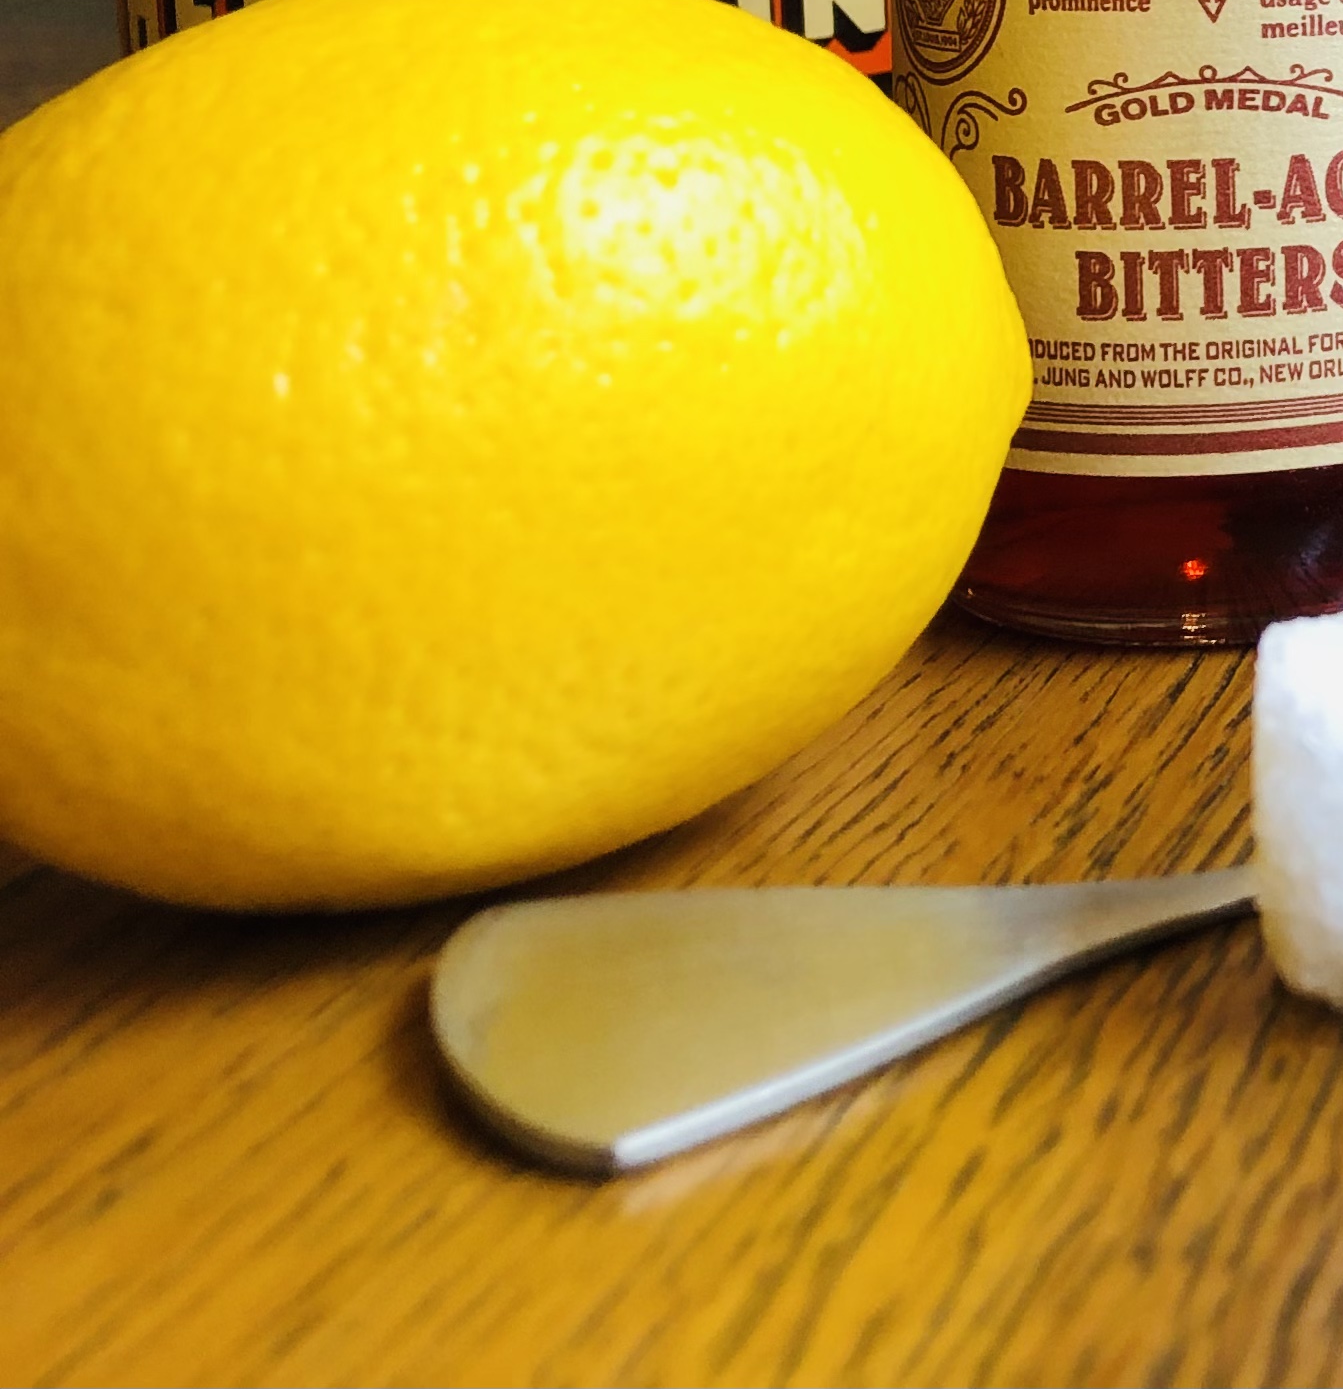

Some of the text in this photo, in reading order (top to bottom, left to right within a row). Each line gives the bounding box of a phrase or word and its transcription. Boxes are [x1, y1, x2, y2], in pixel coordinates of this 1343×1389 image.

[1093, 88, 1330, 127] GOLD MEDAL
[1030, 338, 1096, 363] DUCED
[1100, 340, 1156, 364] FROM
[1163, 341, 1201, 363] THE
[1205, 334, 1304, 361] ORIGINAL
[1040, 365, 1091, 389] JUNG
[1093, 367, 1138, 389] AND
[1140, 366, 1210, 390] WOLFF
[1213, 366, 1256, 390] CO.,
[1258, 360, 1304, 387] NEW
